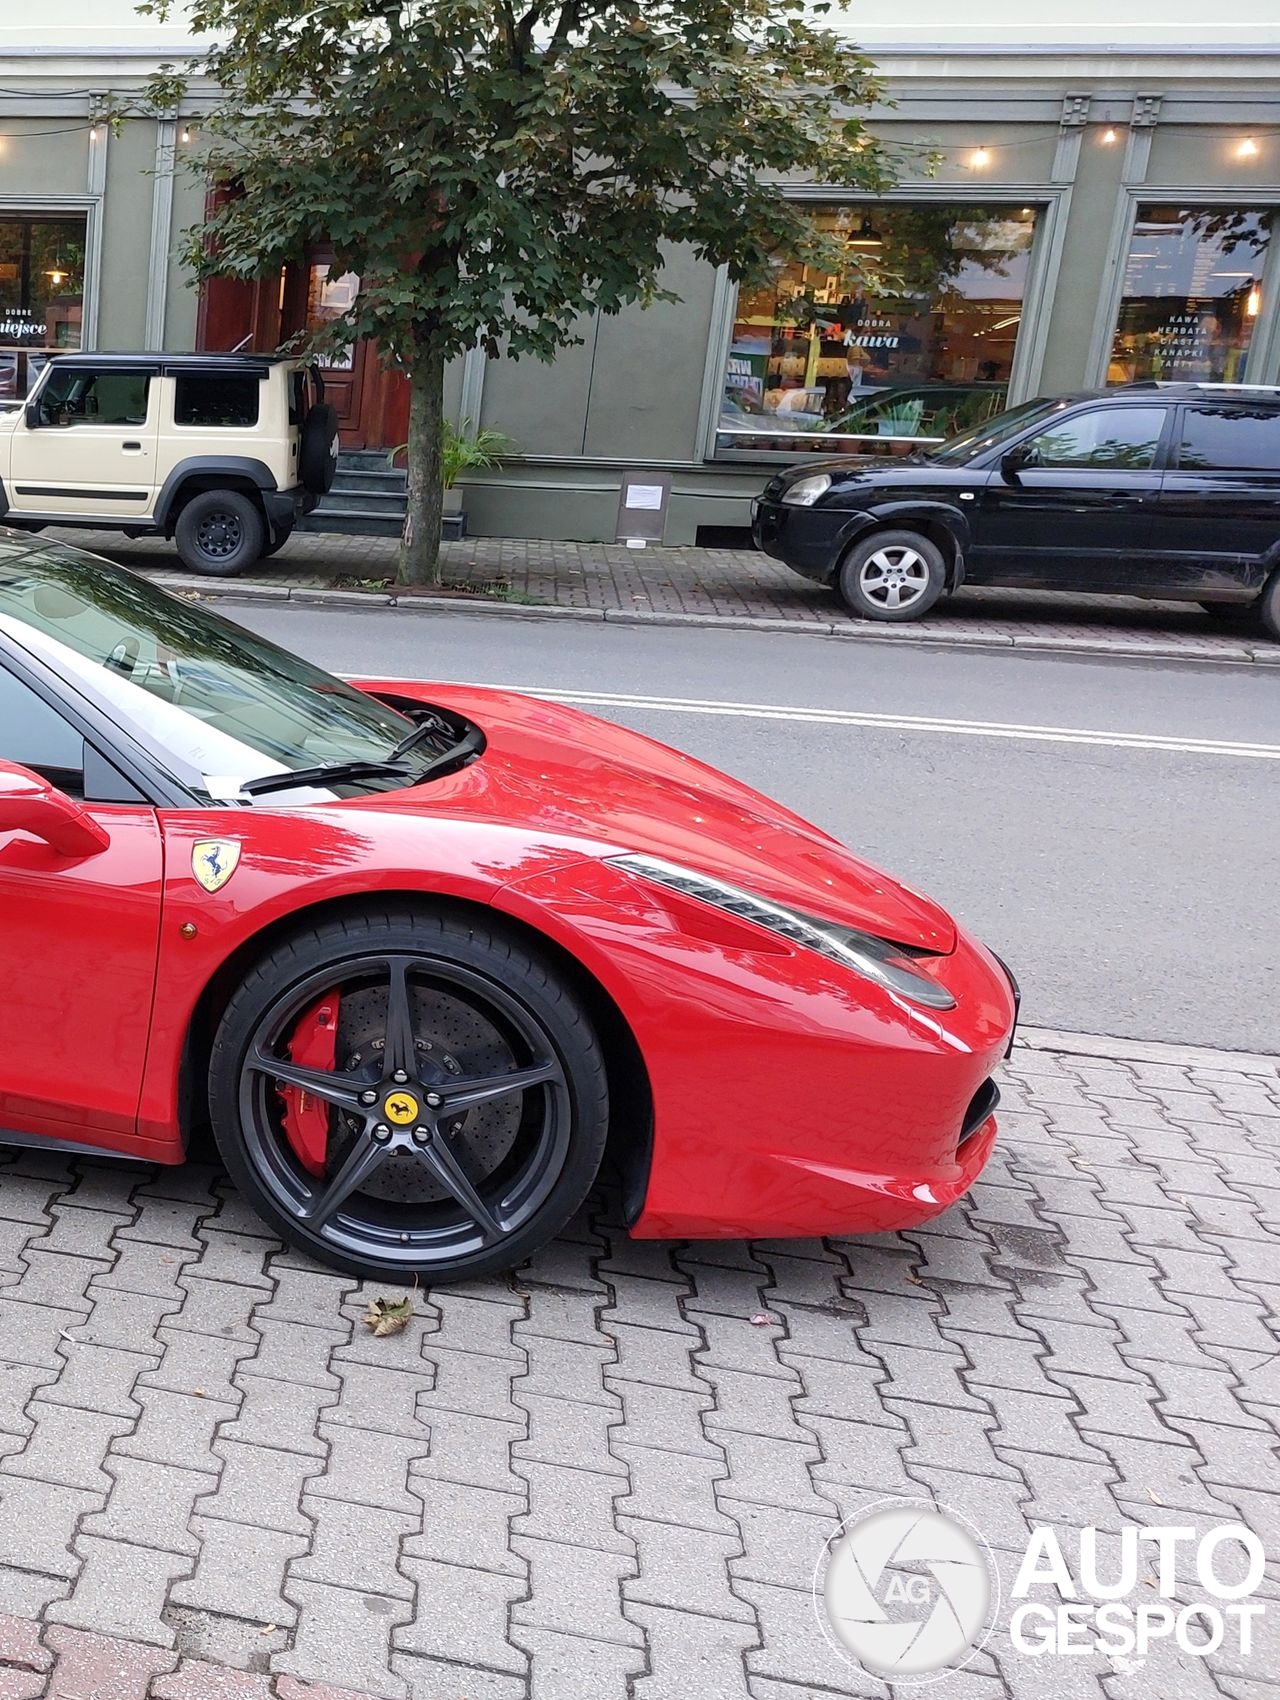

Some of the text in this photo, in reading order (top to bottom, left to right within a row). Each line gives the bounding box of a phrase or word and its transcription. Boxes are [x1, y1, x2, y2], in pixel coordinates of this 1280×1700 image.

[5, 308, 32, 316] DOBRE
[857, 319, 891, 327] DOBRA
[1169, 315, 1199, 324] KAWA
[1157, 326, 1207, 335] HERBATA
[843, 329, 899, 348] kawa
[1160, 338, 1200, 346] CIASTA
[1153, 348, 1203, 357] KANAPKI
[1160, 360, 1192, 368] TARTY
